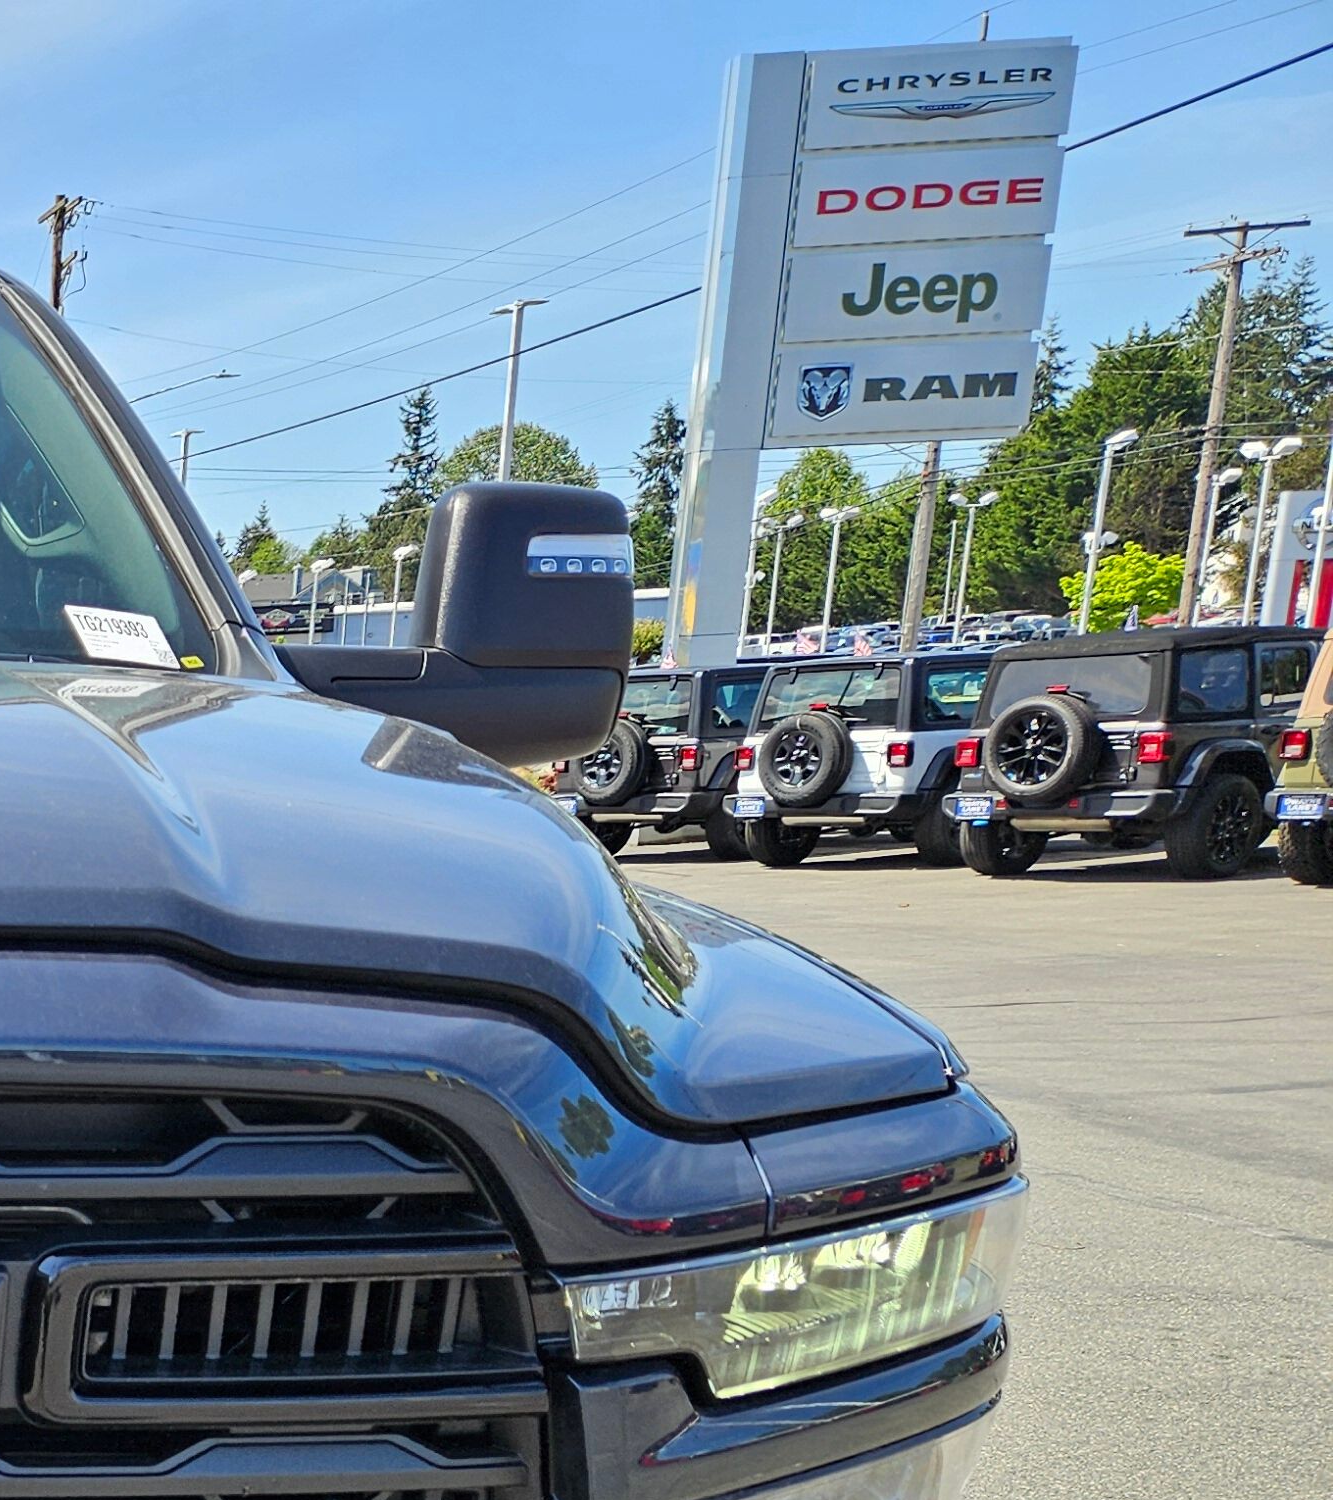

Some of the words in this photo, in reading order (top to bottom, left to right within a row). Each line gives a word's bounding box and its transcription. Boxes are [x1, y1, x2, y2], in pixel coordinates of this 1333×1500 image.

[836, 67, 1053, 94] CHRYSLER
[816, 177, 1044, 215] DODGE
[842, 262, 998, 324] Jeep
[863, 372, 1019, 403] RAM
[73, 613, 149, 639] TG219393
